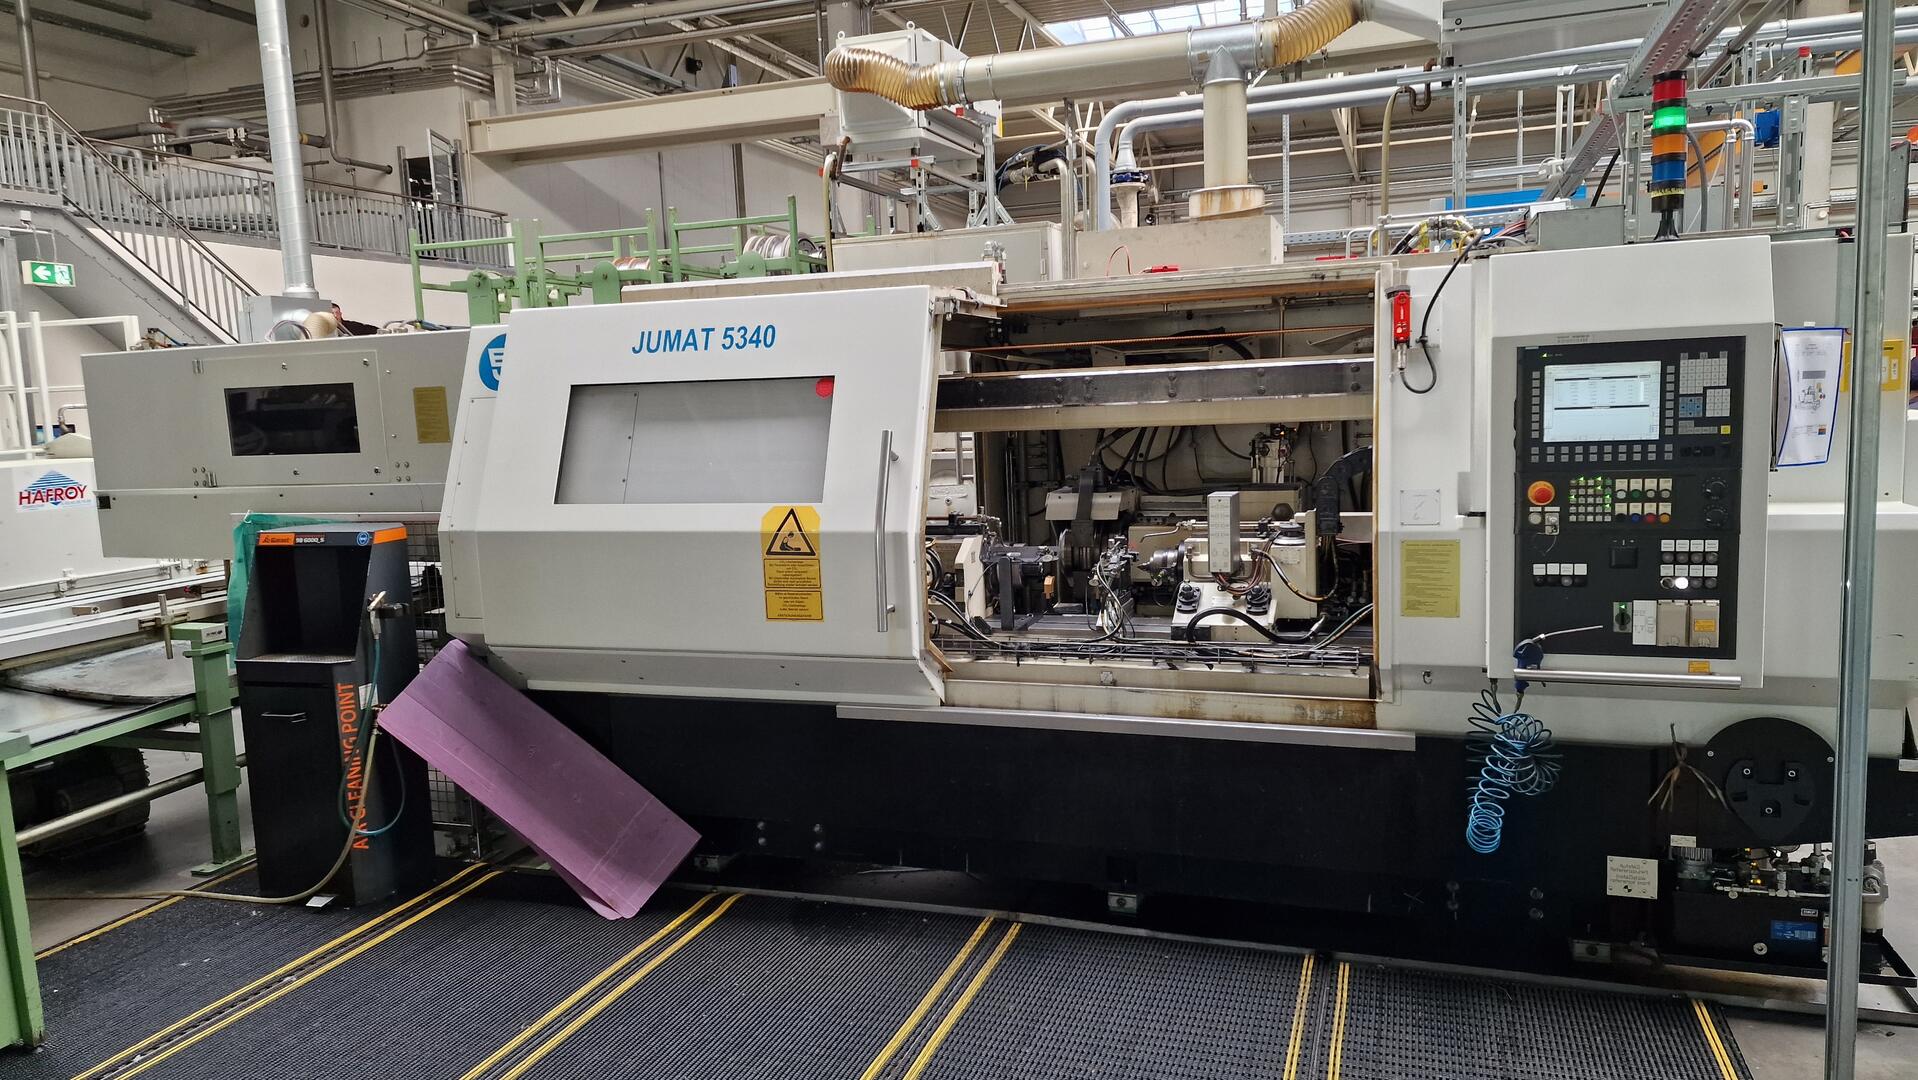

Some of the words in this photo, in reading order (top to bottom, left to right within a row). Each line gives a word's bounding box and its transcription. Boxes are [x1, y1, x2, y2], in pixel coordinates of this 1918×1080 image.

[632, 328, 715, 354] JUMAT
[721, 325, 776, 350] 5340
[19, 485, 87, 505] HAFROY
[337, 683, 358, 733] POINT
